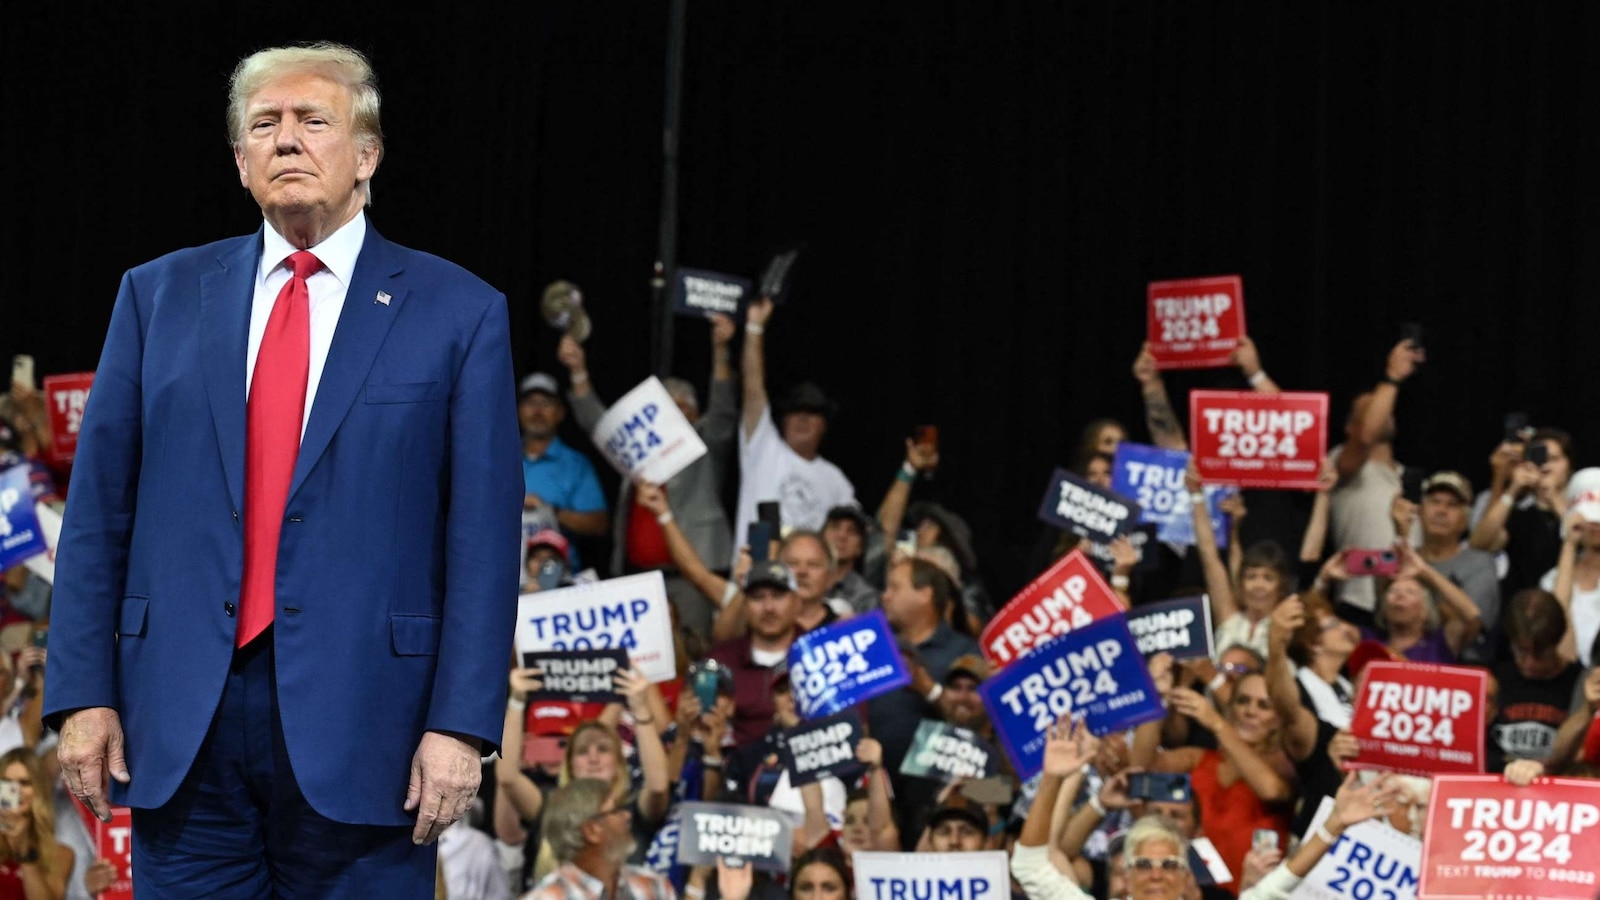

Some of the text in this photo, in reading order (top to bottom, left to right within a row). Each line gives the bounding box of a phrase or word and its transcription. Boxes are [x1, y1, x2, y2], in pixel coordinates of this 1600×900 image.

[1154, 293, 1232, 320] TRUMP
[1161, 317, 1220, 342] 2024
[1202, 407, 1315, 436] TRUMP
[1217, 431, 1299, 459] 2024
[1125, 461, 1188, 491] TRU
[1059, 480, 1129, 520] TRUMP
[530, 599, 650, 640] TRUMP
[989, 574, 1088, 662] TRUMP
[534, 658, 618, 676] TRUMP
[1001, 639, 1122, 716] TRUMP
[543, 675, 614, 693] NOEM
[1028, 669, 1119, 733] 2024
[1366, 680, 1473, 719] TRUMP
[1370, 709, 1455, 747] 2024
[693, 812, 782, 837] TRUMP
[1446, 797, 1600, 835] TRUMP
[698, 833, 774, 858] NOEM
[1460, 829, 1573, 865] 2024
[1436, 864, 1470, 878] TEXT
[1473, 864, 1523, 880] TRUMP
[1526, 866, 1546, 880] TO
[869, 876, 990, 900] TRUMP
